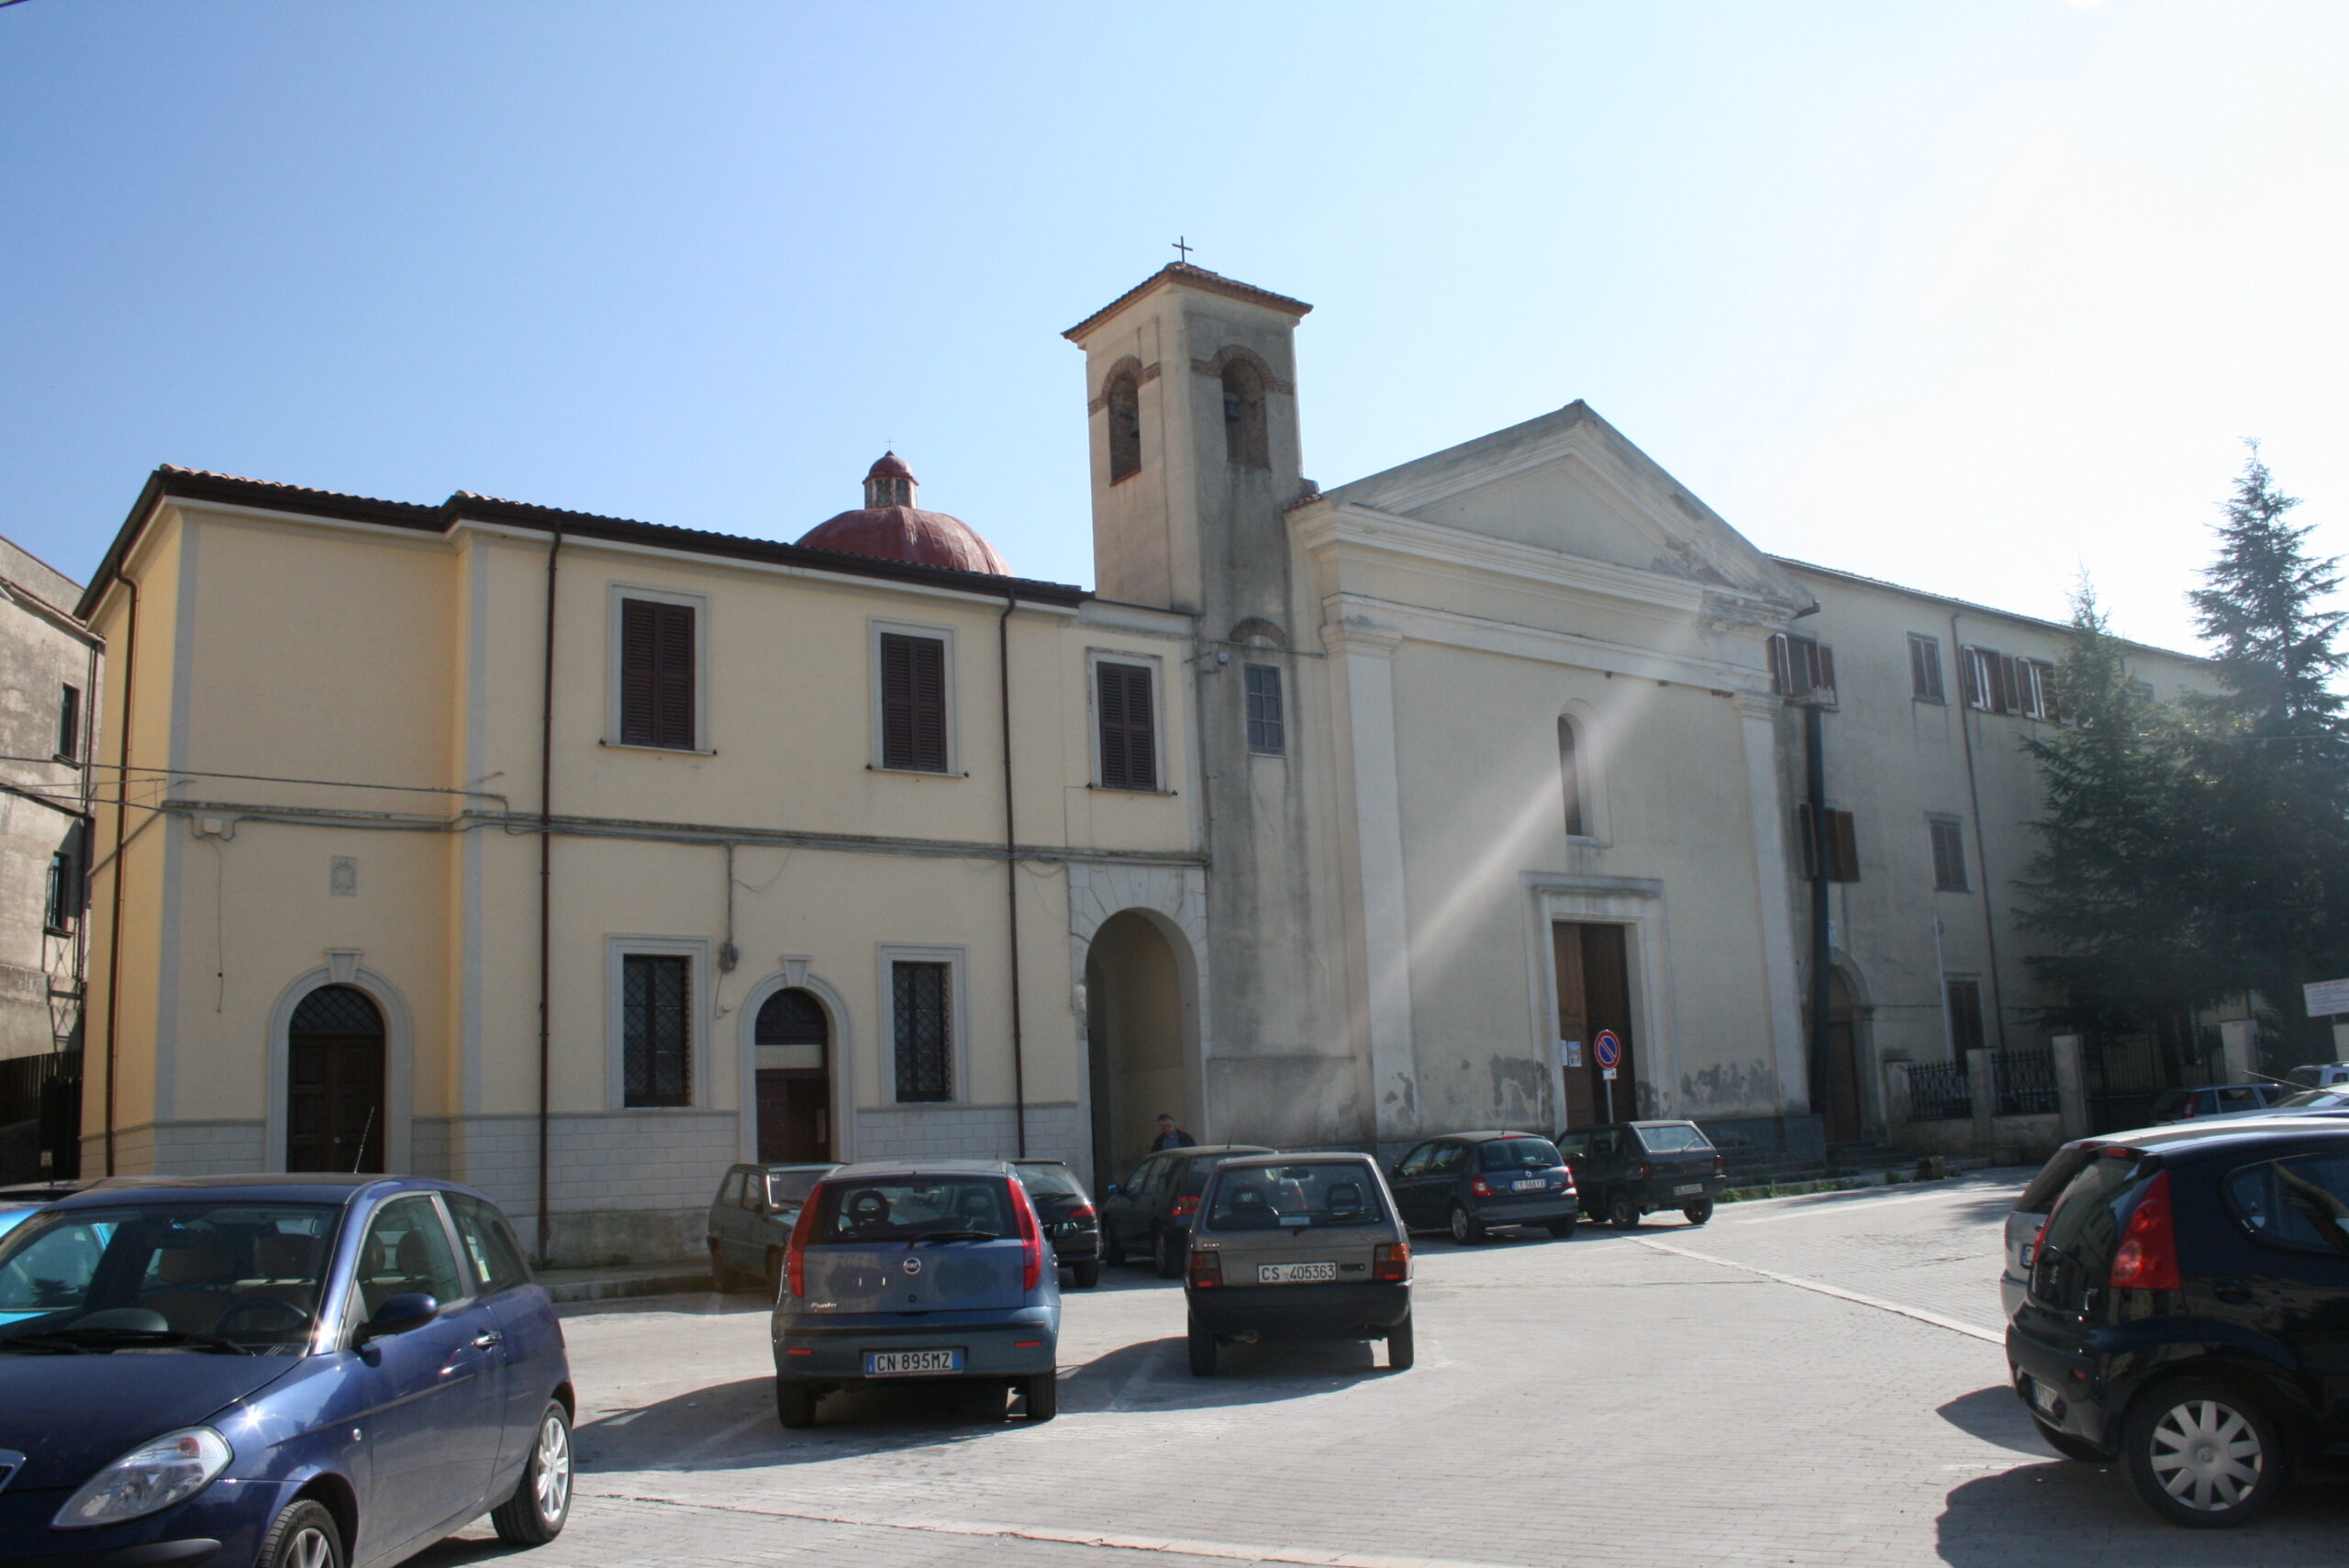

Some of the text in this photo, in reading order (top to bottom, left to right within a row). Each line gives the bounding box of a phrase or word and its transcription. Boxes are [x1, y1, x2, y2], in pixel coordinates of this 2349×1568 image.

[1262, 1264, 1335, 1281] CS 405363
[877, 1355, 896, 1370] CN
[903, 1352, 951, 1368] 895MZ
